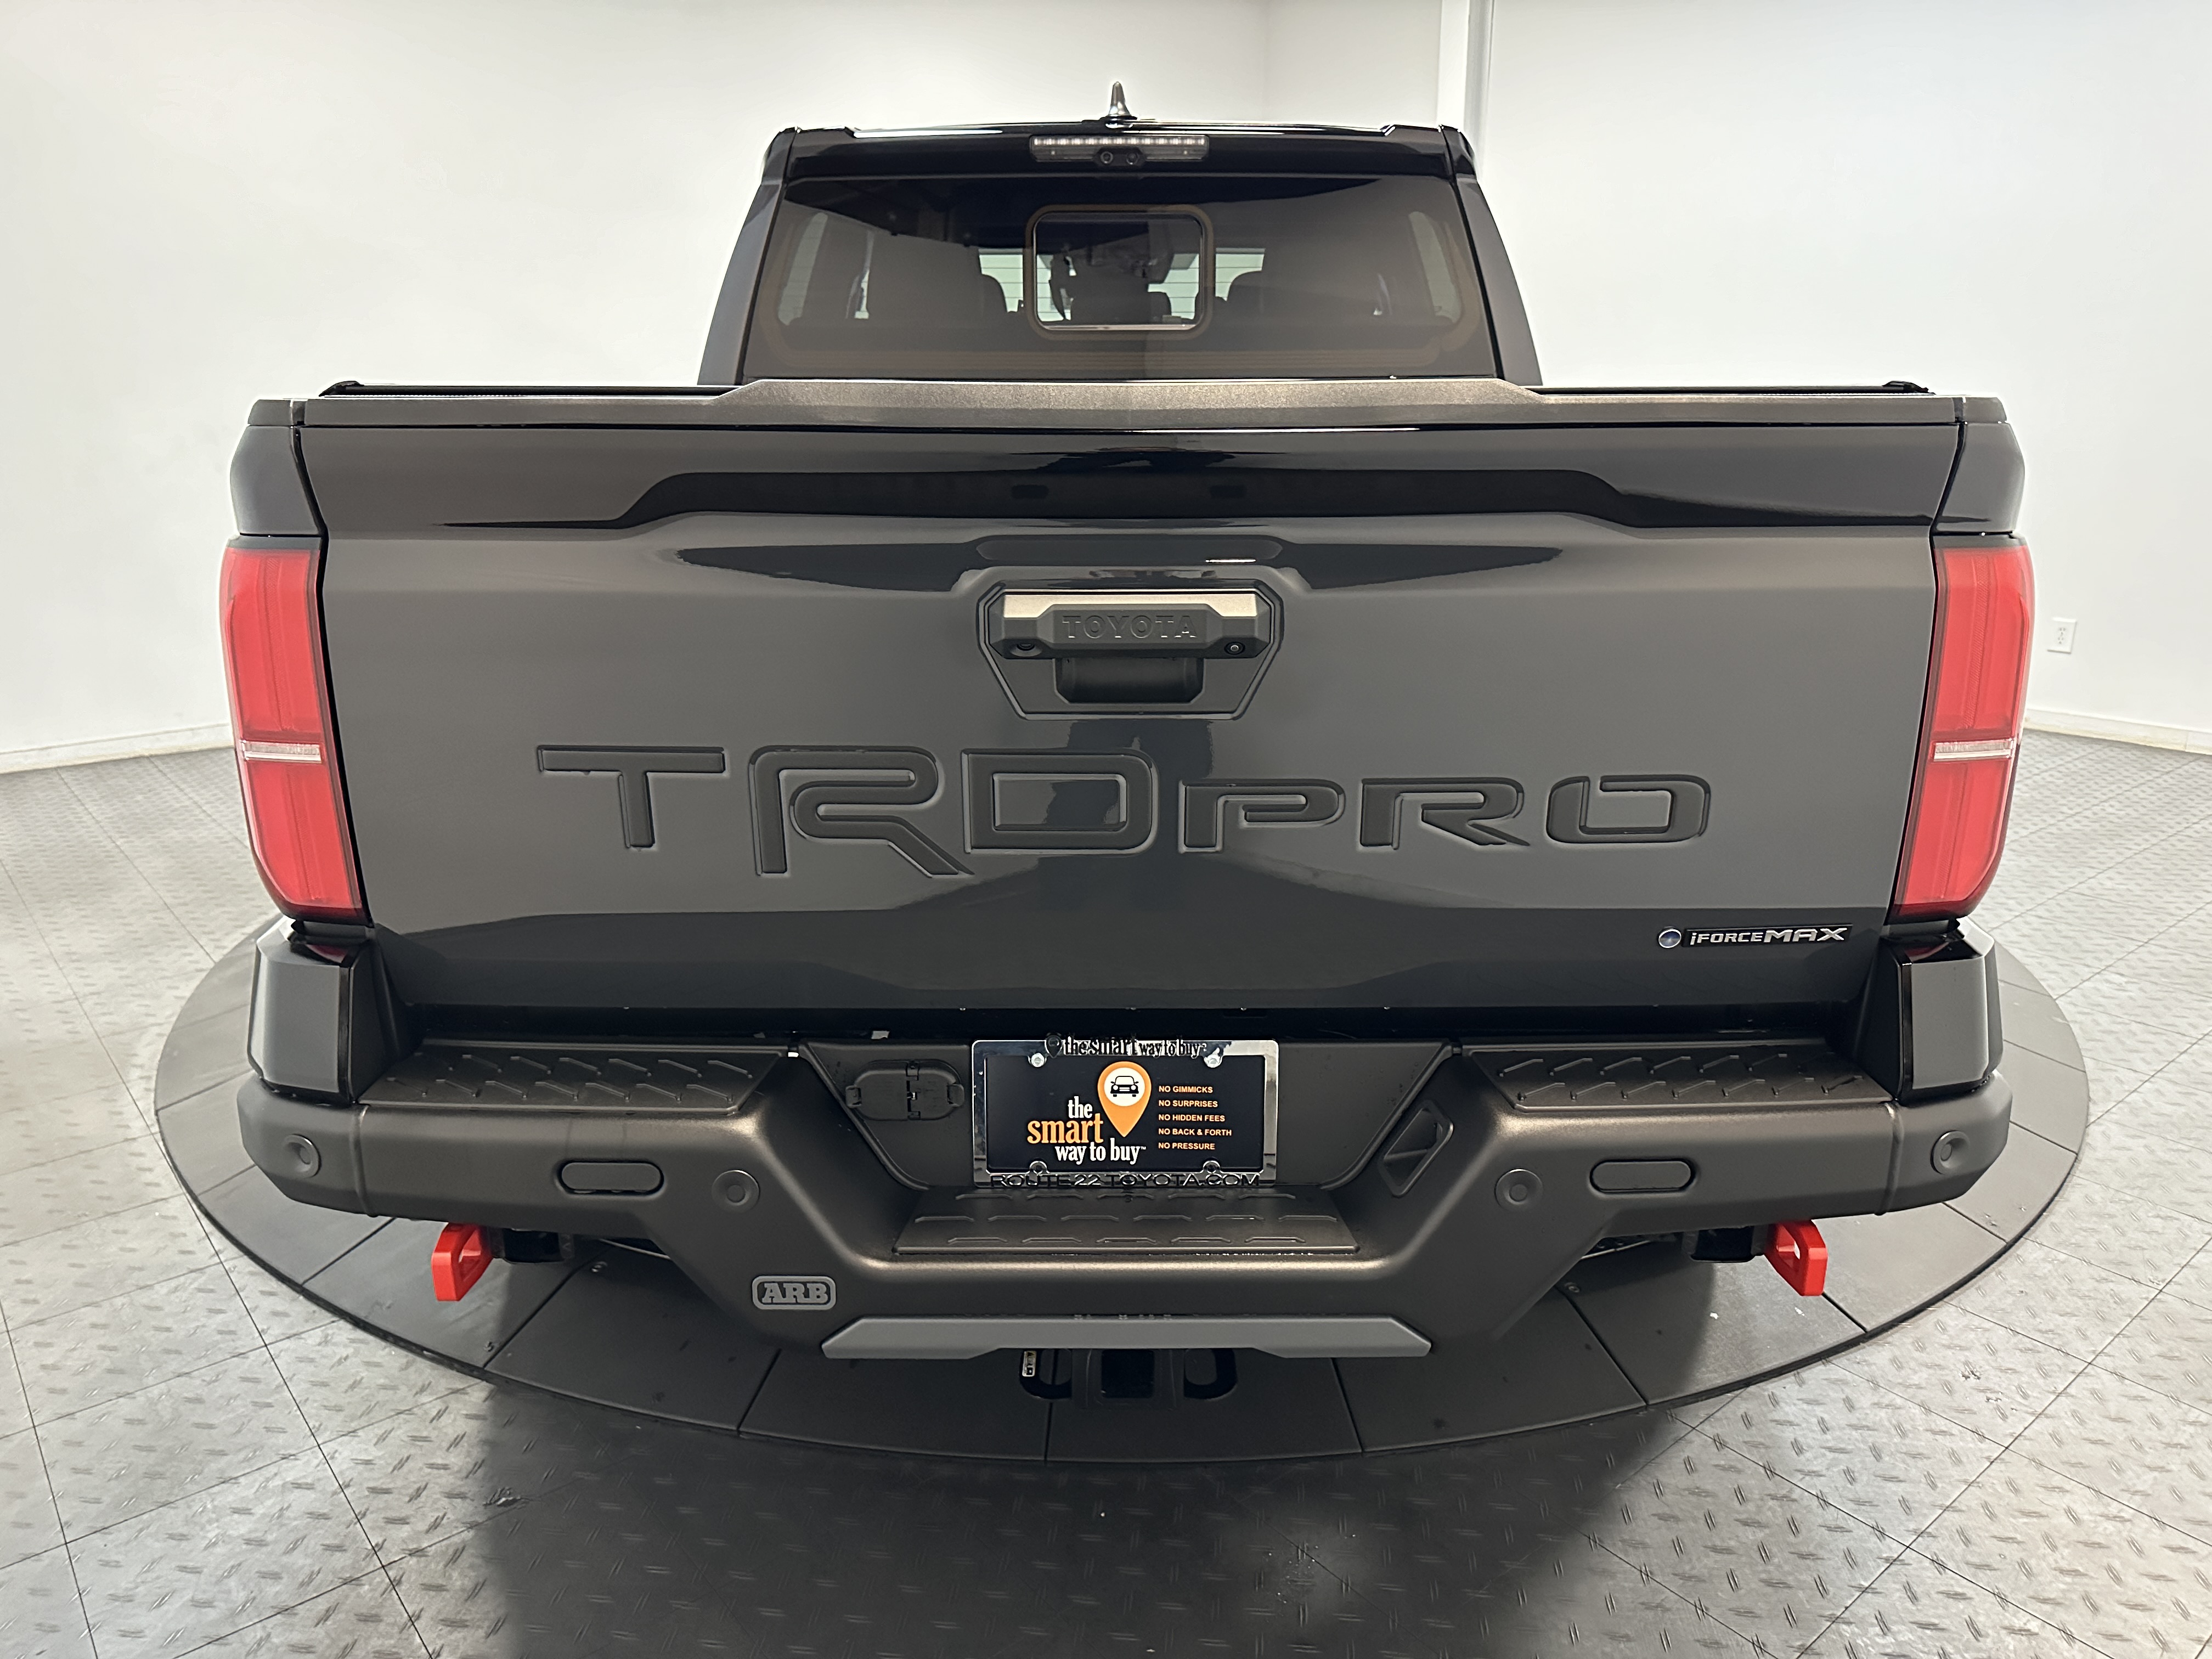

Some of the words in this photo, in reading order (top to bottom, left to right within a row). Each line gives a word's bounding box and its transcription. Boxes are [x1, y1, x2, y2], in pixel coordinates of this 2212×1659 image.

[1062, 615, 1198, 639] TOYOTA
[538, 744, 1159, 877] TRD
[1178, 774, 1712, 855] PRO
[1068, 1096, 1093, 1119] the
[1027, 1113, 1104, 1144] smart
[1054, 1146, 1087, 1165] way
[1090, 1142, 1106, 1161] to
[990, 1174, 1071, 1187] ROUTE
[1074, 1174, 1102, 1186] 22
[761, 1283, 828, 1304] ARB
